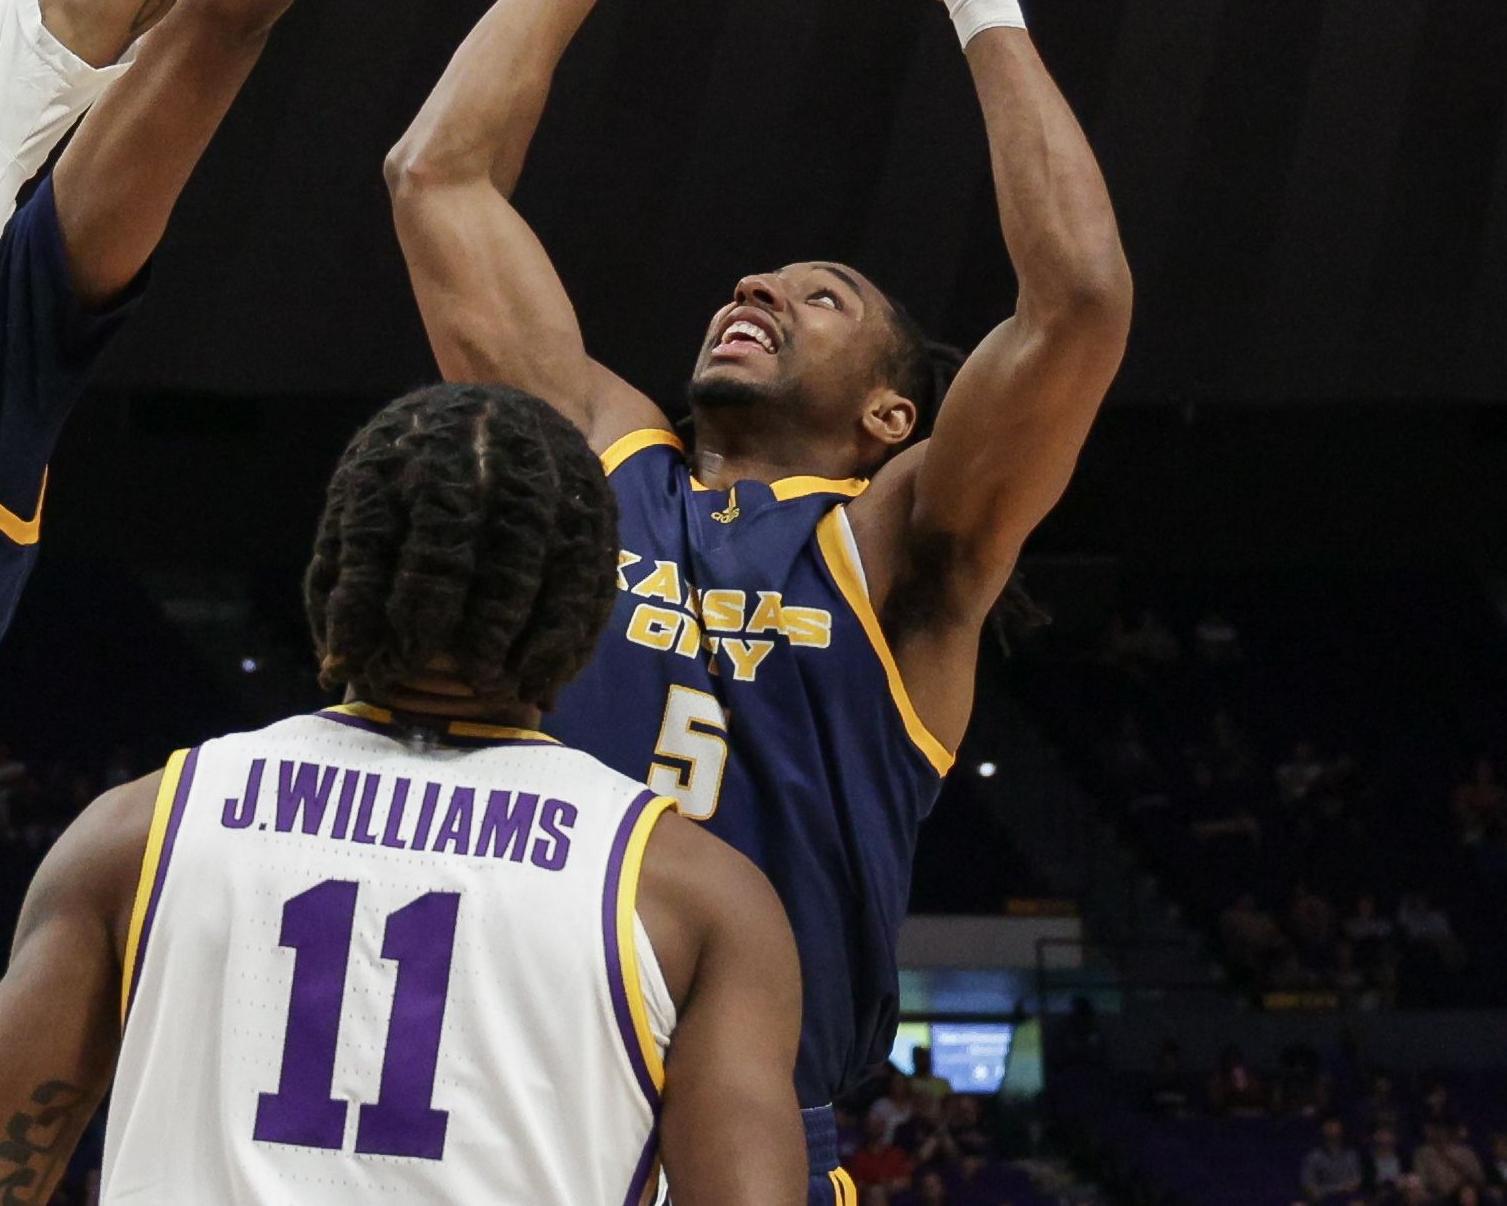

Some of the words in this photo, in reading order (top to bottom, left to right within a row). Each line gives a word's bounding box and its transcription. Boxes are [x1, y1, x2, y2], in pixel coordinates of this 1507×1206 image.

[220, 757, 579, 872] J.WILLIAMS
[647, 683, 728, 821] 5
[252, 878, 462, 1161] 11
